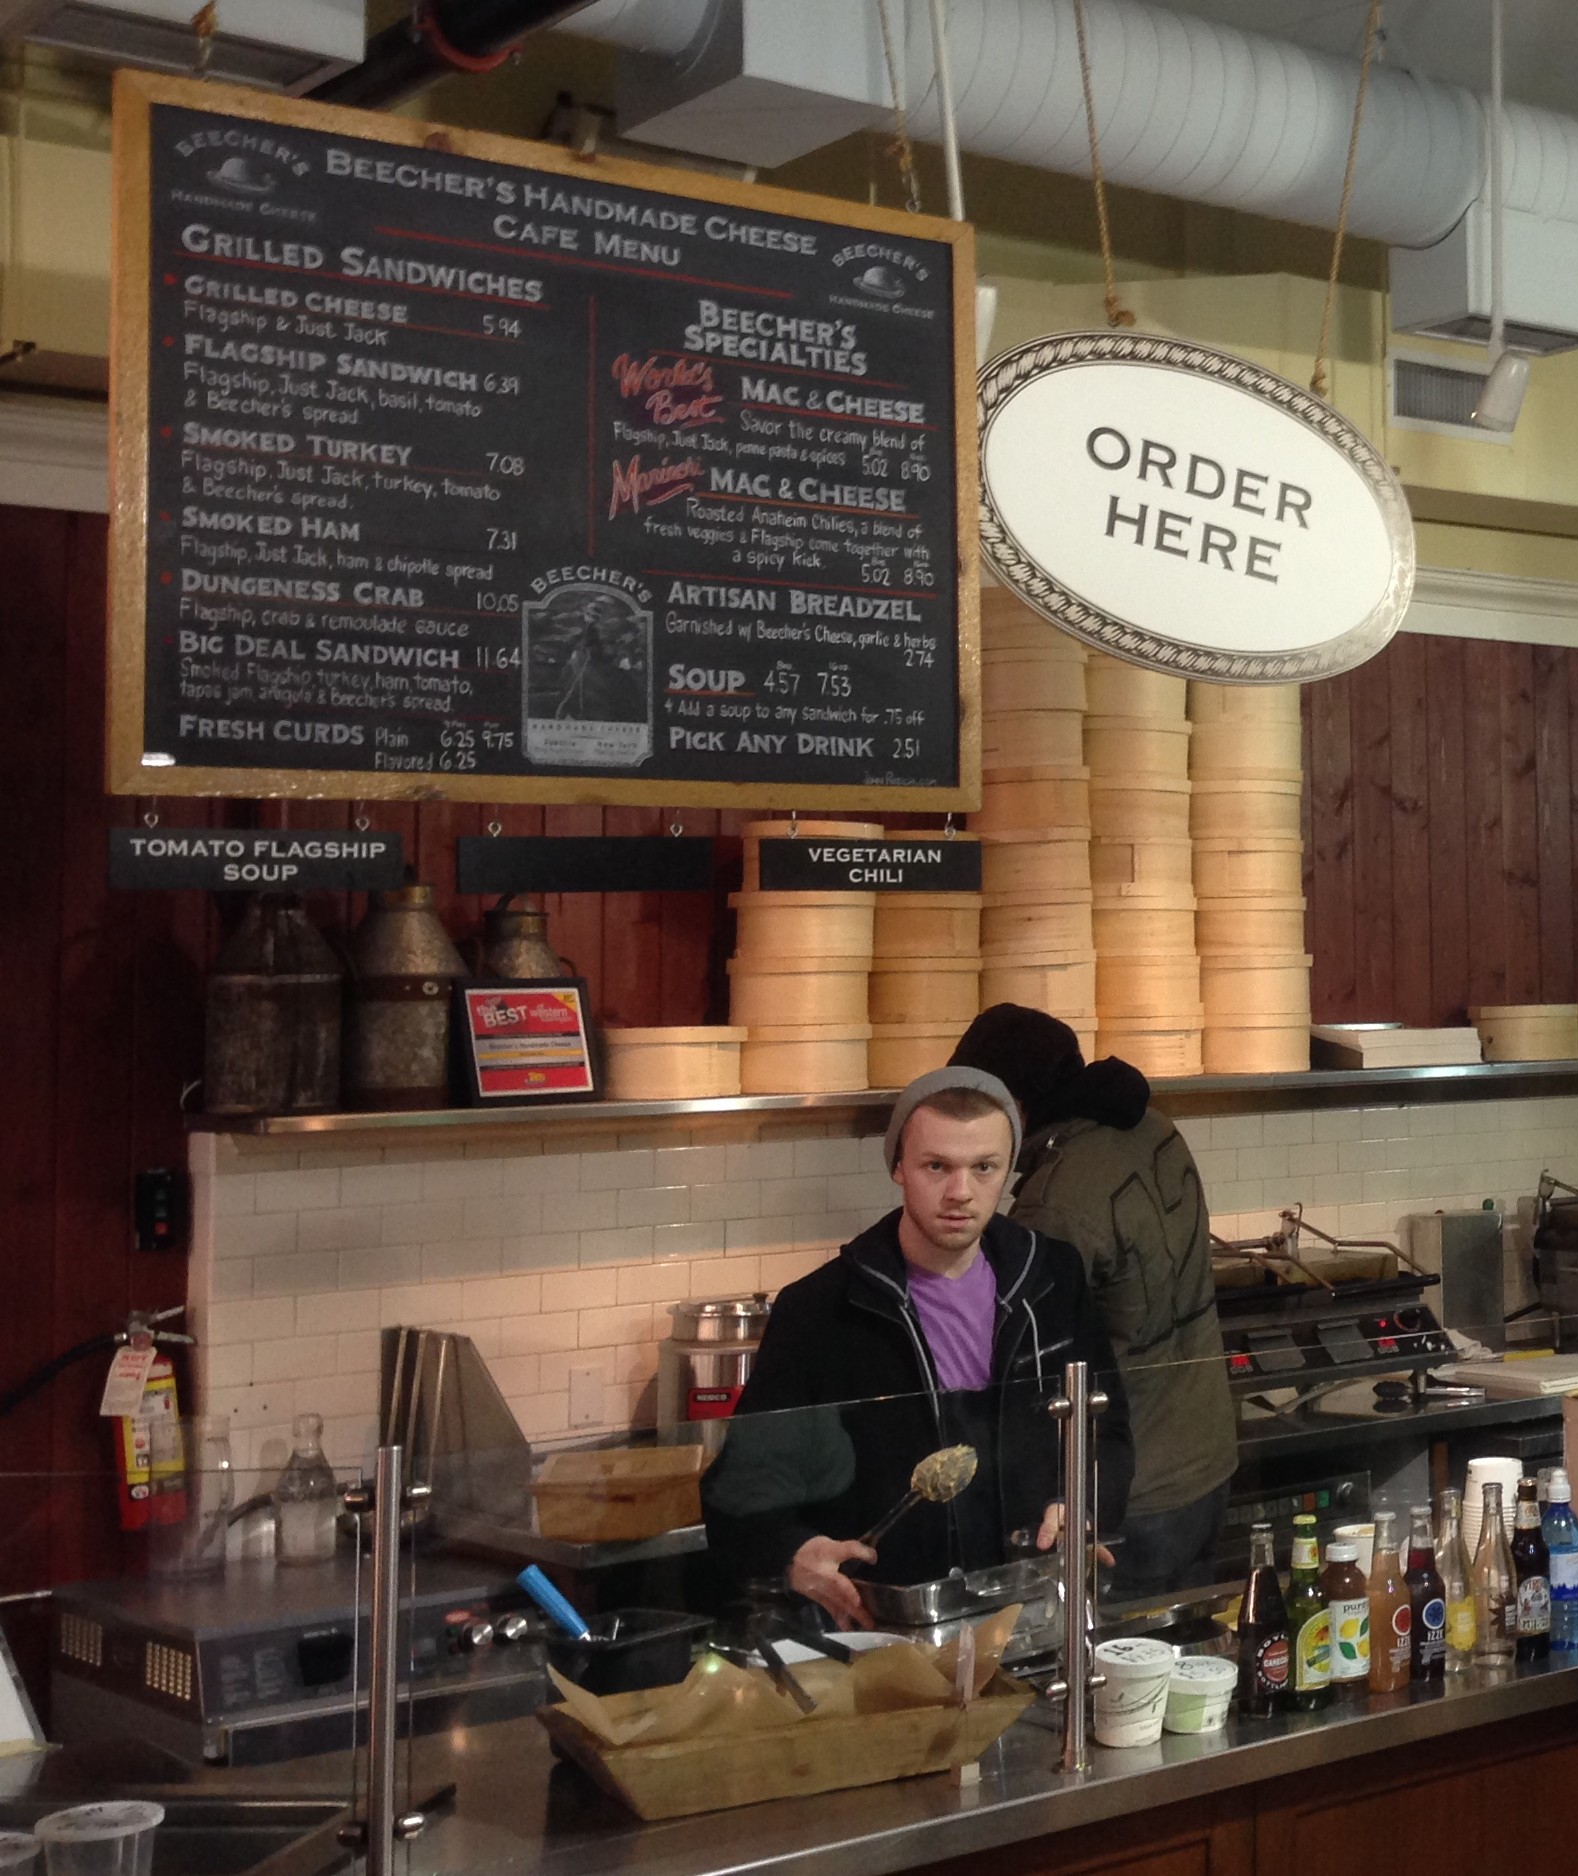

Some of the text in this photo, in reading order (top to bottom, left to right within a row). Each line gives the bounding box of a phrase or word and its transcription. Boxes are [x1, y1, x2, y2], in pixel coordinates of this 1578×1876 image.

[175, 129, 310, 176] BEECHER'S
[326, 148, 818, 256] BEECHER'S HANDMADE CHEESE
[495, 213, 681, 266] CAFE MENU
[181, 222, 544, 302] GRILLED SANDWICHES
[832, 244, 929, 281] BEECHER'S
[184, 275, 408, 325] GRILLED CHEESE
[184, 300, 388, 346] Flagship & Just Jack
[700, 299, 858, 350] BEECHER'S
[184, 333, 521, 396] FLAGSHIP SANDWICH 6.39
[683, 324, 868, 376] SPECIALTIES
[278, 373, 321, 399] Just
[425, 393, 483, 418] tomato
[645, 388, 723, 426] Best
[741, 375, 925, 424] MAC & CHEESE
[183, 421, 525, 476] SMOKED TURKEY 7.08
[740, 409, 782, 436] Savor
[788, 419, 814, 440] the
[819, 428, 868, 452] creamy
[872, 429, 906, 450] blend
[910, 433, 926, 451] of
[182, 476, 196, 493] &
[277, 460, 313, 484] Just
[441, 478, 501, 501] tomato
[710, 467, 906, 512] MAC & CHEESE
[1085, 425, 1313, 531] ORDER
[182, 505, 517, 550] SMOKED HAM 7.31
[644, 516, 682, 537] fresh
[687, 525, 734, 545] veggies
[751, 528, 803, 551] Flagship
[687, 497, 744, 523] Roasted
[752, 506, 807, 528] Anaheim
[873, 520, 903, 538] blend
[907, 524, 923, 540] of
[1103, 494, 1284, 584] HERE
[256, 540, 288, 563] Just
[336, 548, 368, 569] ham
[387, 554, 440, 578] chipotle
[445, 564, 494, 586] spread
[747, 550, 785, 572] spicy
[182, 568, 340, 602] DUNGENESS
[353, 582, 424, 607] CRAB
[530, 565, 654, 604] BEECHER'S
[667, 581, 921, 622] ARTISAN BREADZEL
[261, 608, 300, 626] crab
[415, 619, 470, 638] sauce
[665, 610, 733, 636] Garnished
[756, 619, 811, 641] Beecher's
[858, 630, 890, 650] garlic
[179, 630, 224, 654] BIG
[234, 634, 306, 660] DEAL
[315, 639, 460, 668] SANDWICH
[668, 663, 746, 694] SOUP
[179, 713, 265, 740] FRESH
[273, 720, 364, 745] CURDS
[375, 727, 409, 747] Plain
[678, 700, 700, 716] Add
[706, 704, 714, 717] a
[720, 704, 751, 723] soup
[755, 703, 770, 718] to
[775, 705, 797, 725] any
[802, 705, 857, 723] sandwich
[860, 706, 879, 723] for
[906, 710, 926, 726] off
[669, 726, 726, 751] PICK
[735, 731, 788, 754] ANY
[796, 732, 875, 757] DRINK
[129, 838, 387, 861] TOMATO FLAGSHIP
[808, 847, 942, 864] VEGETARIAN
[222, 863, 299, 883] SOUP
[849, 868, 904, 884] CHILI
[482, 1005, 527, 1029] BEST
